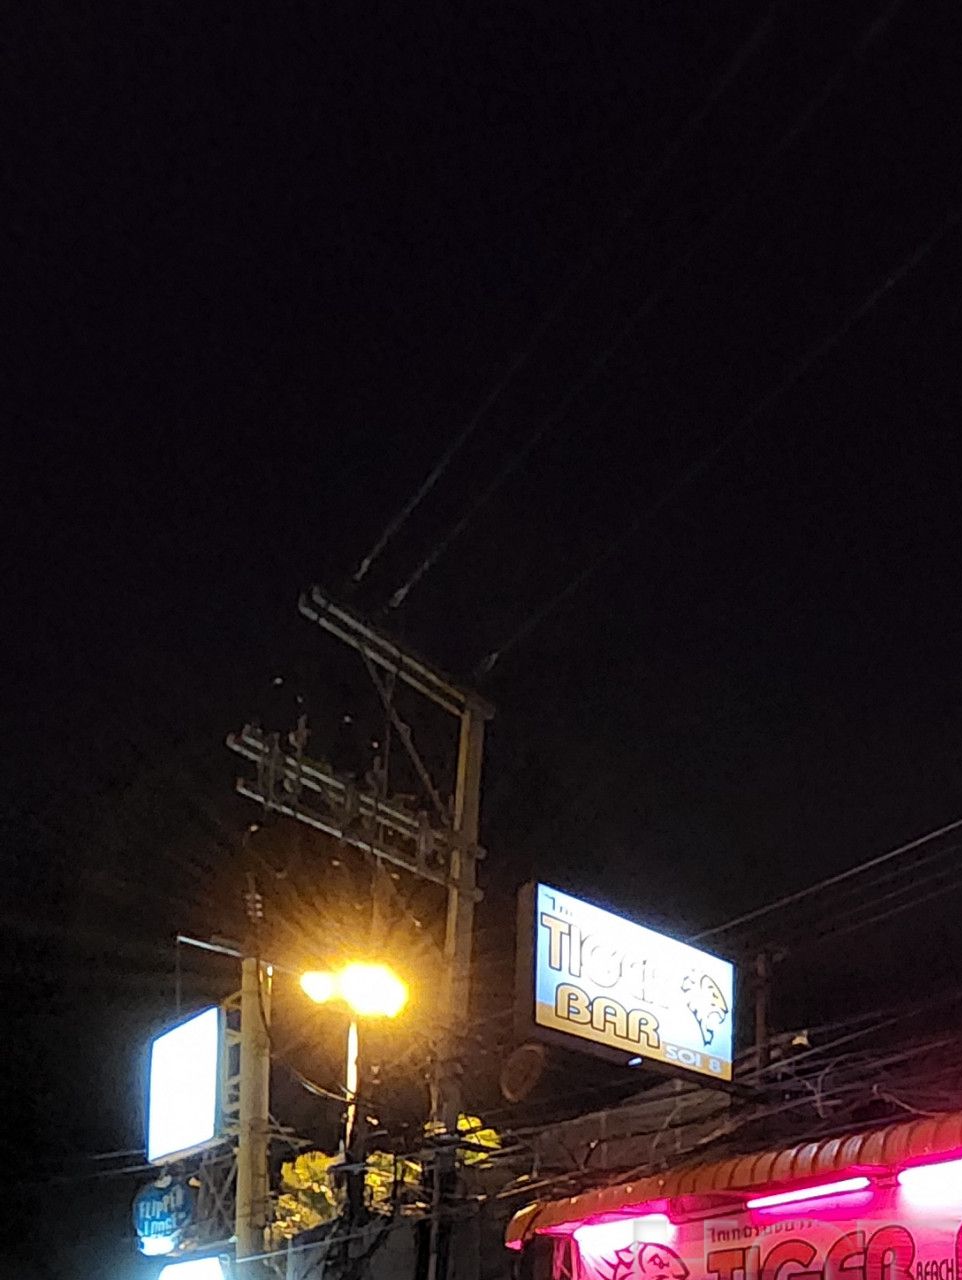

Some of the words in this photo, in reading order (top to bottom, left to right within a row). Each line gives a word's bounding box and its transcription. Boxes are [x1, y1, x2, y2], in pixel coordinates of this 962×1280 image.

[555, 982, 660, 1049] BAR
[665, 1044, 702, 1067] SOI
[708, 1058, 722, 1073] 8
